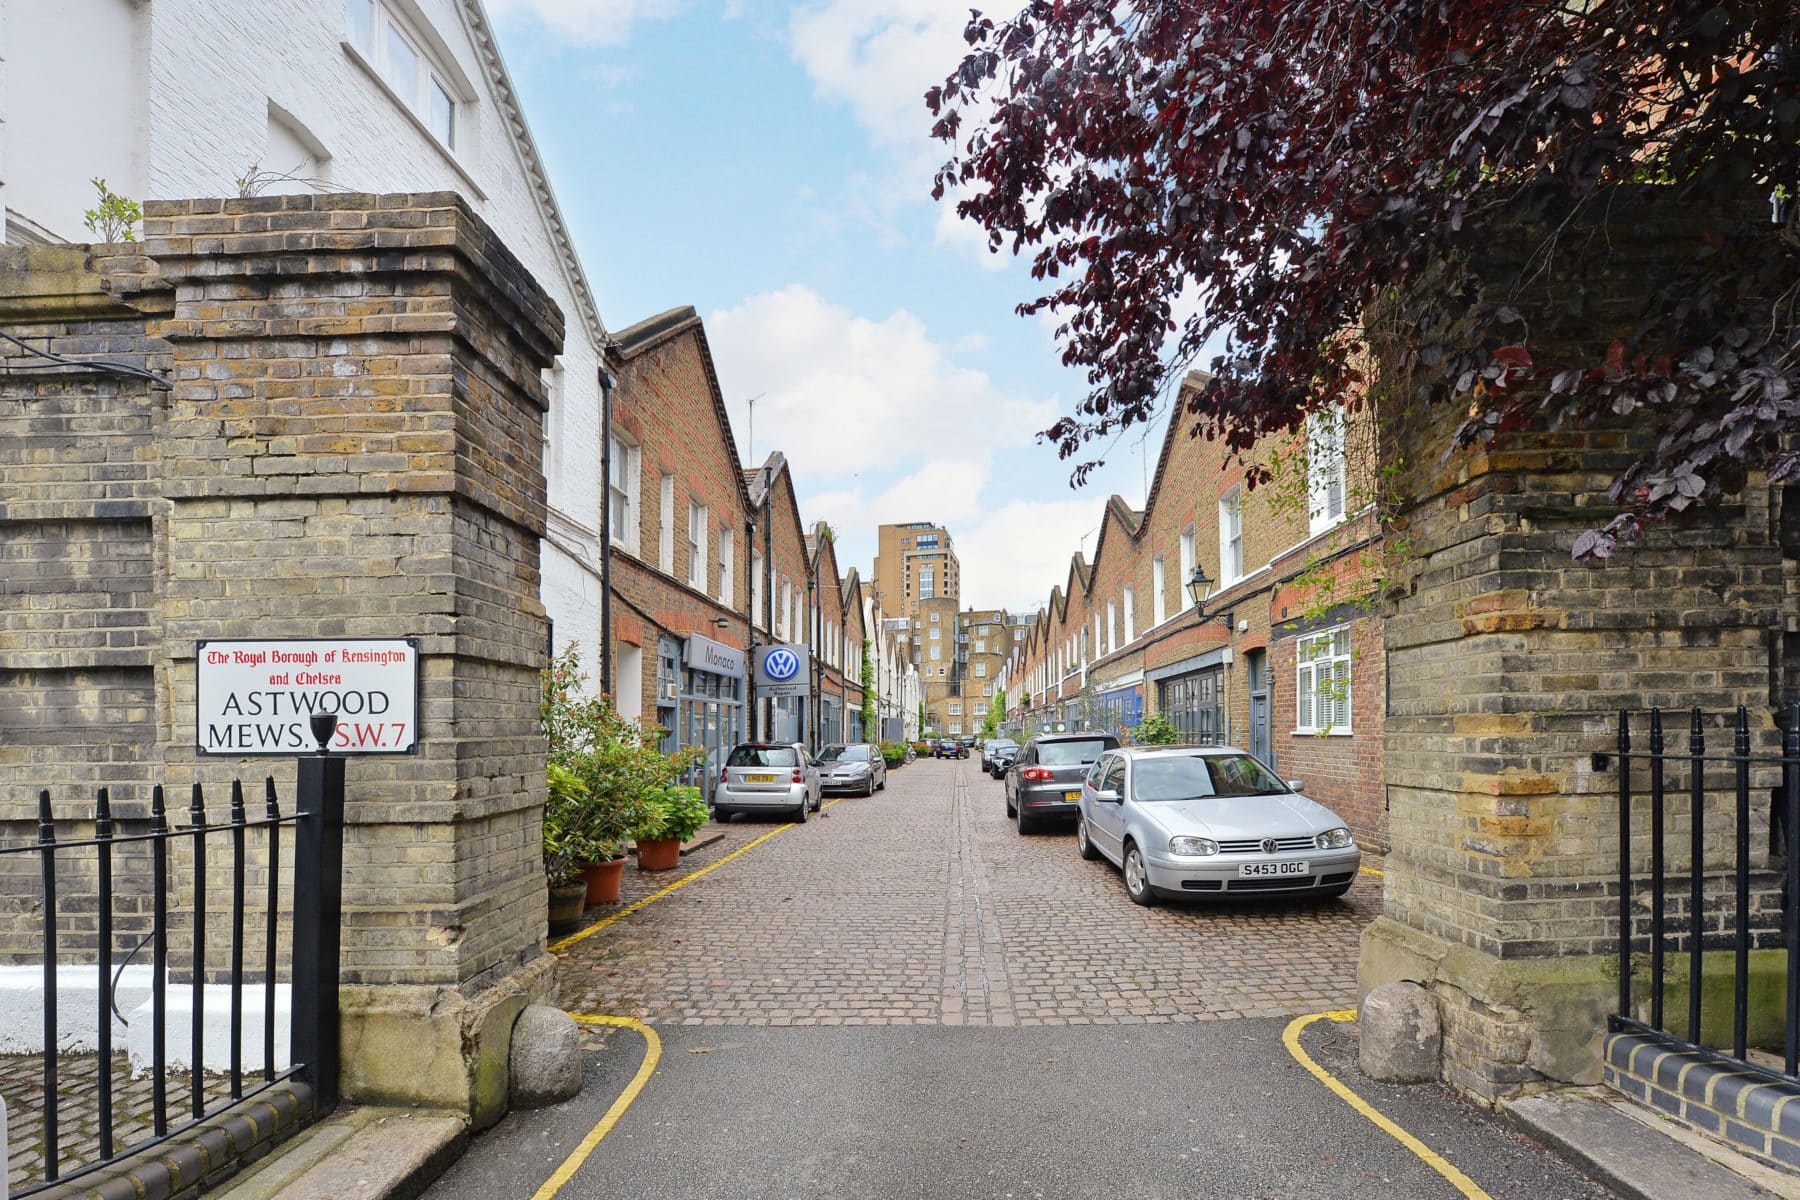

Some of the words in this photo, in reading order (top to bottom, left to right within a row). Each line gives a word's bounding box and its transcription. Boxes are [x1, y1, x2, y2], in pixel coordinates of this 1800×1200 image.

[207, 651, 230, 665] The
[233, 650, 266, 667] Royal
[272, 650, 318, 667] Borough
[324, 650, 337, 664] of
[342, 649, 406, 667] Kensington
[705, 645, 734, 670] Monaco
[269, 672, 289, 685] and
[296, 671, 341, 685] Chelsea
[221, 691, 390, 716] ASTWOOD
[1244, 864, 1277, 875] S453
[1281, 862, 1304, 873] OGC
